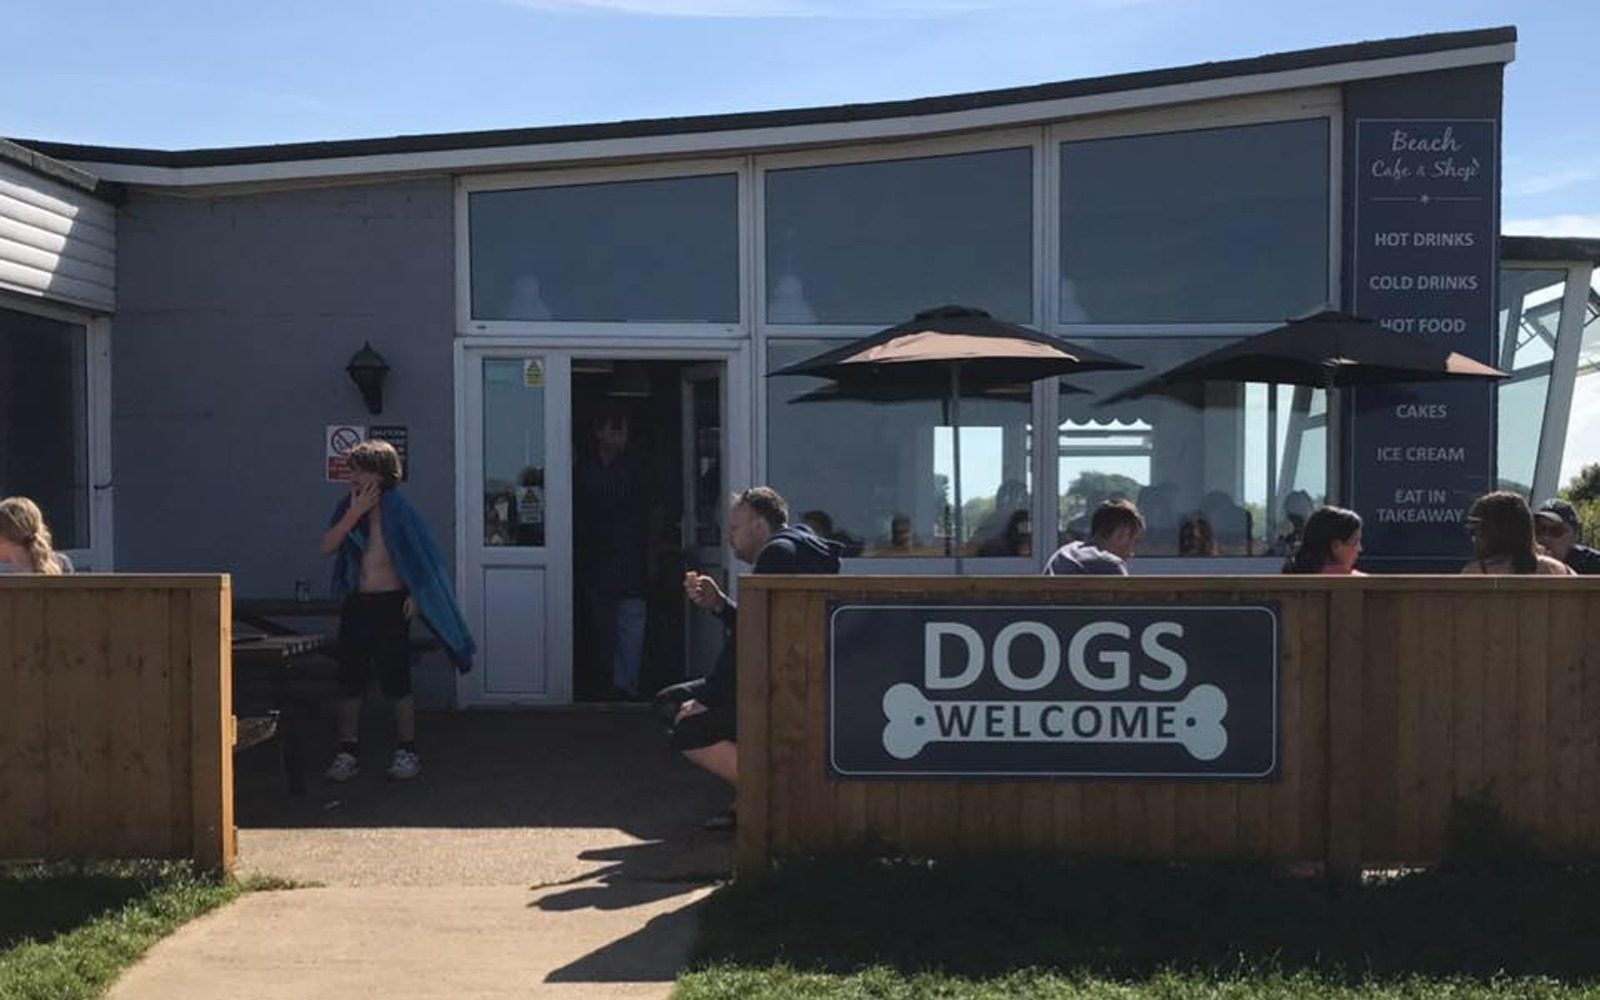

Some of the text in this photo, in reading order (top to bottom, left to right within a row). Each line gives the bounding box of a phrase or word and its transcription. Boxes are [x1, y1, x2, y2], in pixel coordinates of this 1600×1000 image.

[1391, 127, 1461, 153] Beach
[1432, 157, 1480, 181] Shop
[1375, 232, 1474, 247] HOT DRINKS
[1370, 275, 1478, 290] COLD DRINKS
[1418, 318, 1466, 333] FOOD
[1396, 404, 1447, 418] CAKES
[1377, 447, 1465, 462] ICE CREAM
[1395, 489, 1446, 503] EAT IN
[1377, 508, 1464, 523] TAKEAWAY
[924, 621, 1188, 691] DOGS
[936, 705, 1176, 738] WELCOME
